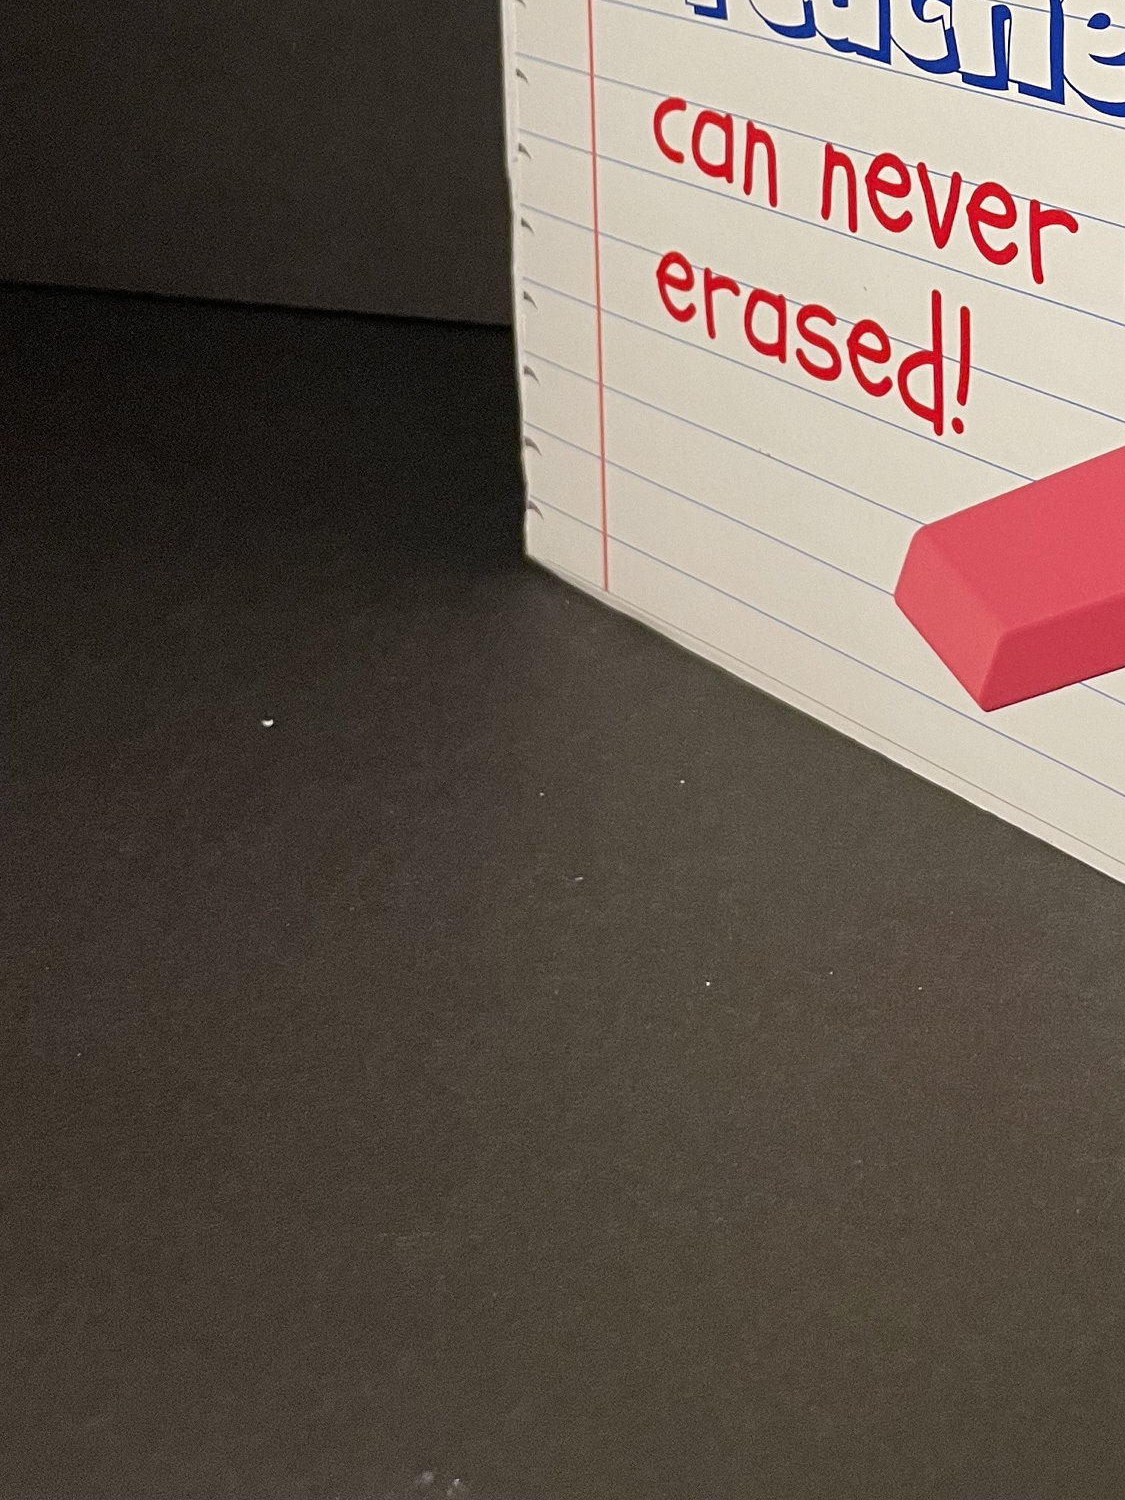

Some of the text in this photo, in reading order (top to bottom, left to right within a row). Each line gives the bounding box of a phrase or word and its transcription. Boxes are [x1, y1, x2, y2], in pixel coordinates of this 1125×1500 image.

[653, 97, 778, 208] can
[821, 142, 1079, 285] never
[655, 251, 972, 437] erased!
